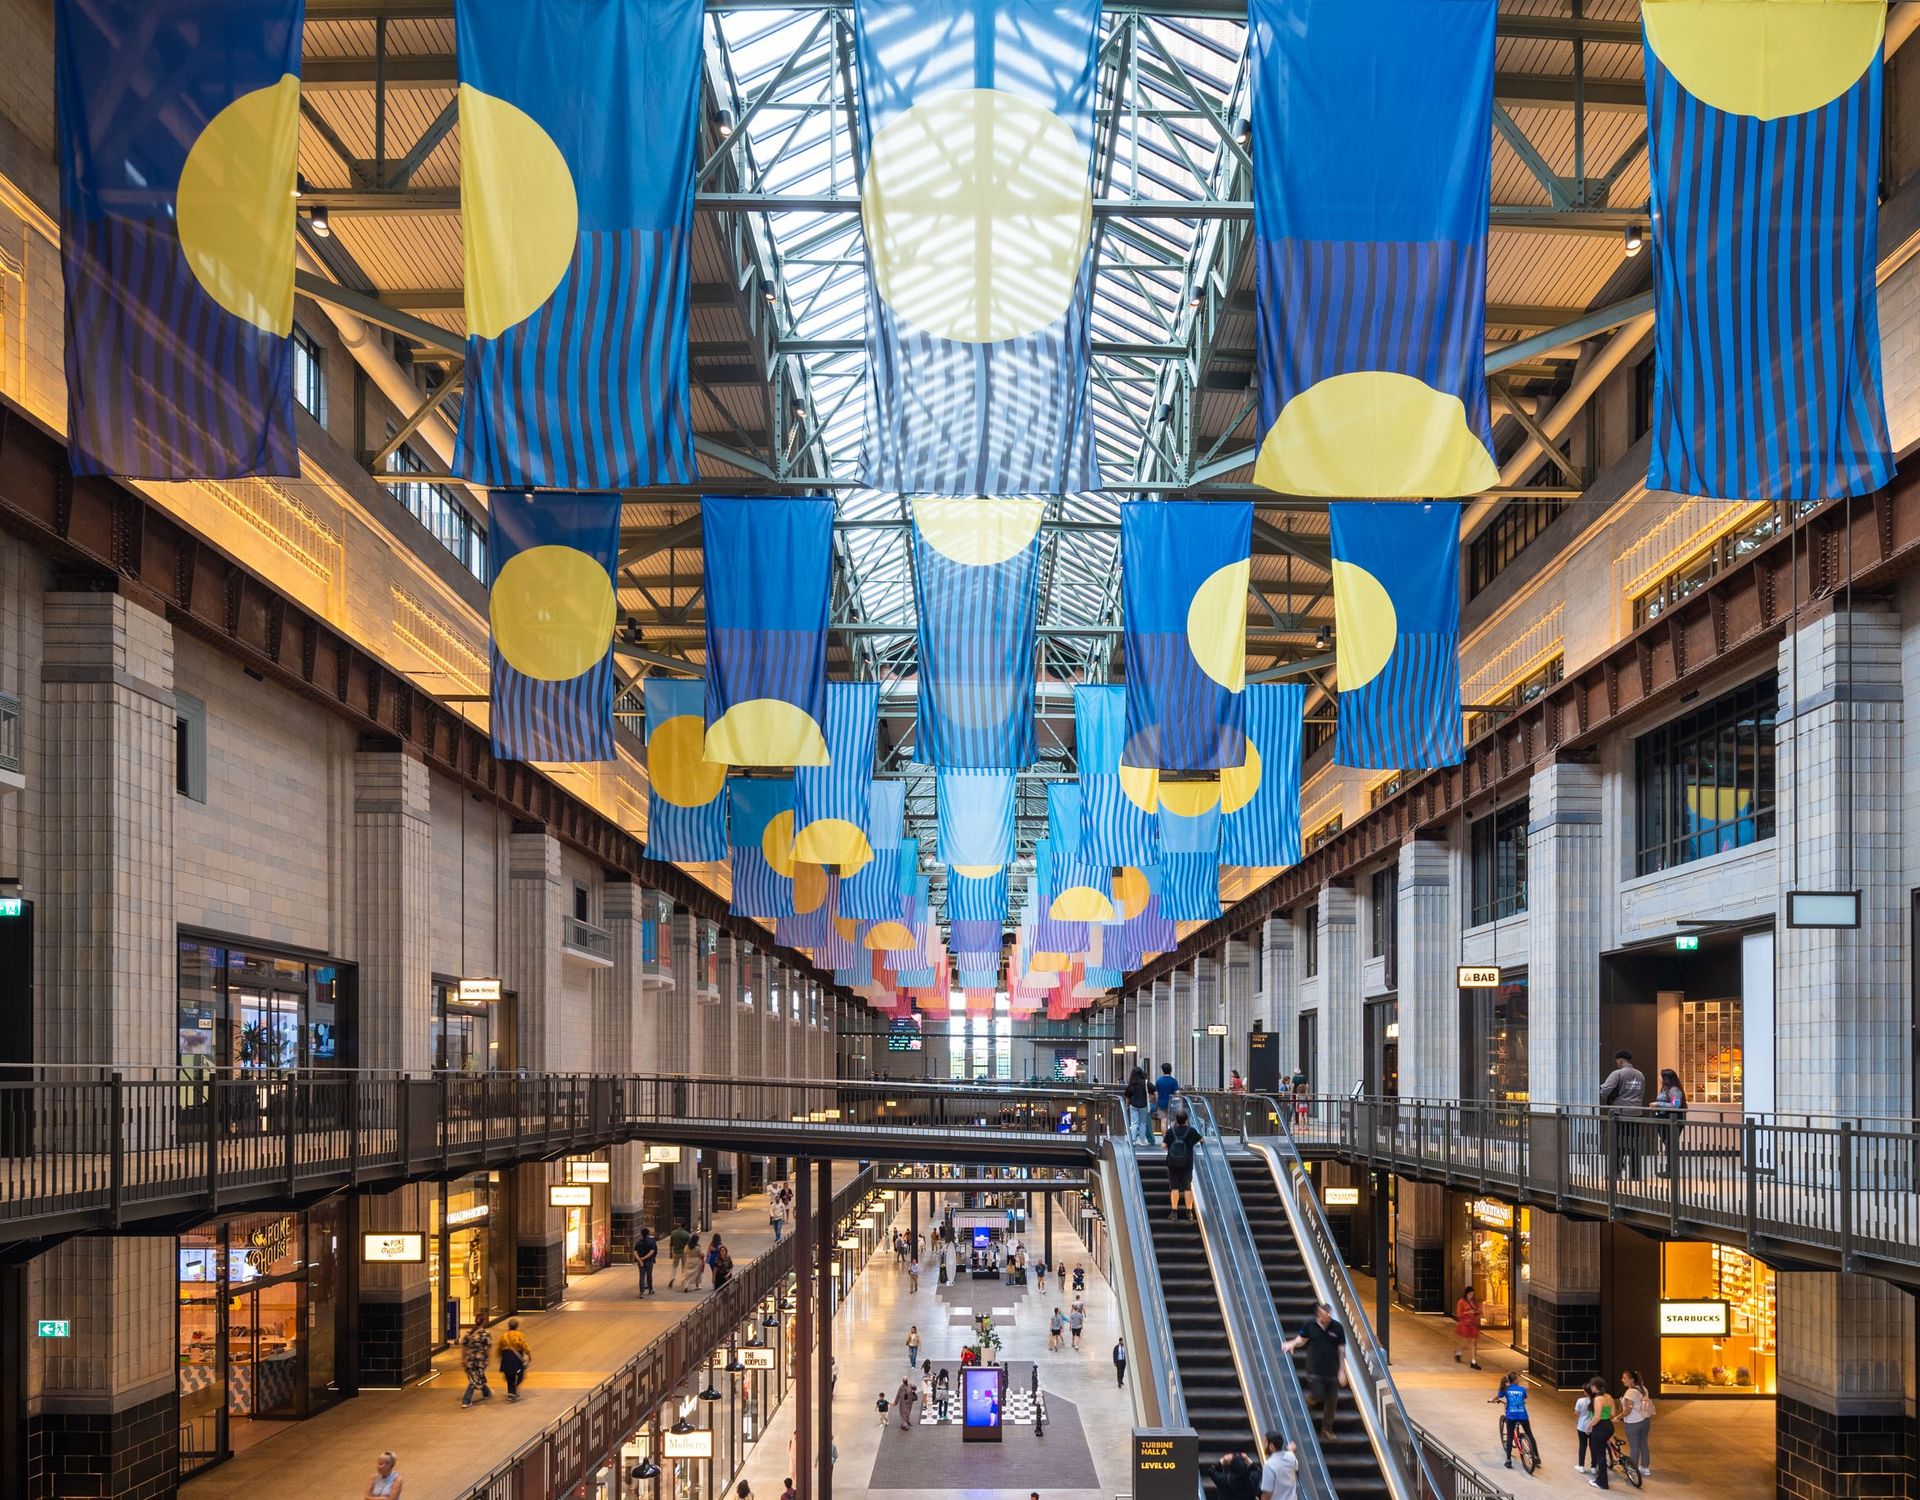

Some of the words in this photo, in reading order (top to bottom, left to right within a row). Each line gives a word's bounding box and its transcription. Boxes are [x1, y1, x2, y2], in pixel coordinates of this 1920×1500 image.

[1473, 973, 1495, 981] BAB
[266, 1216, 291, 1244] POKE
[248, 1237, 291, 1275] HOUSE
[669, 1438, 706, 1449] Mulberry
